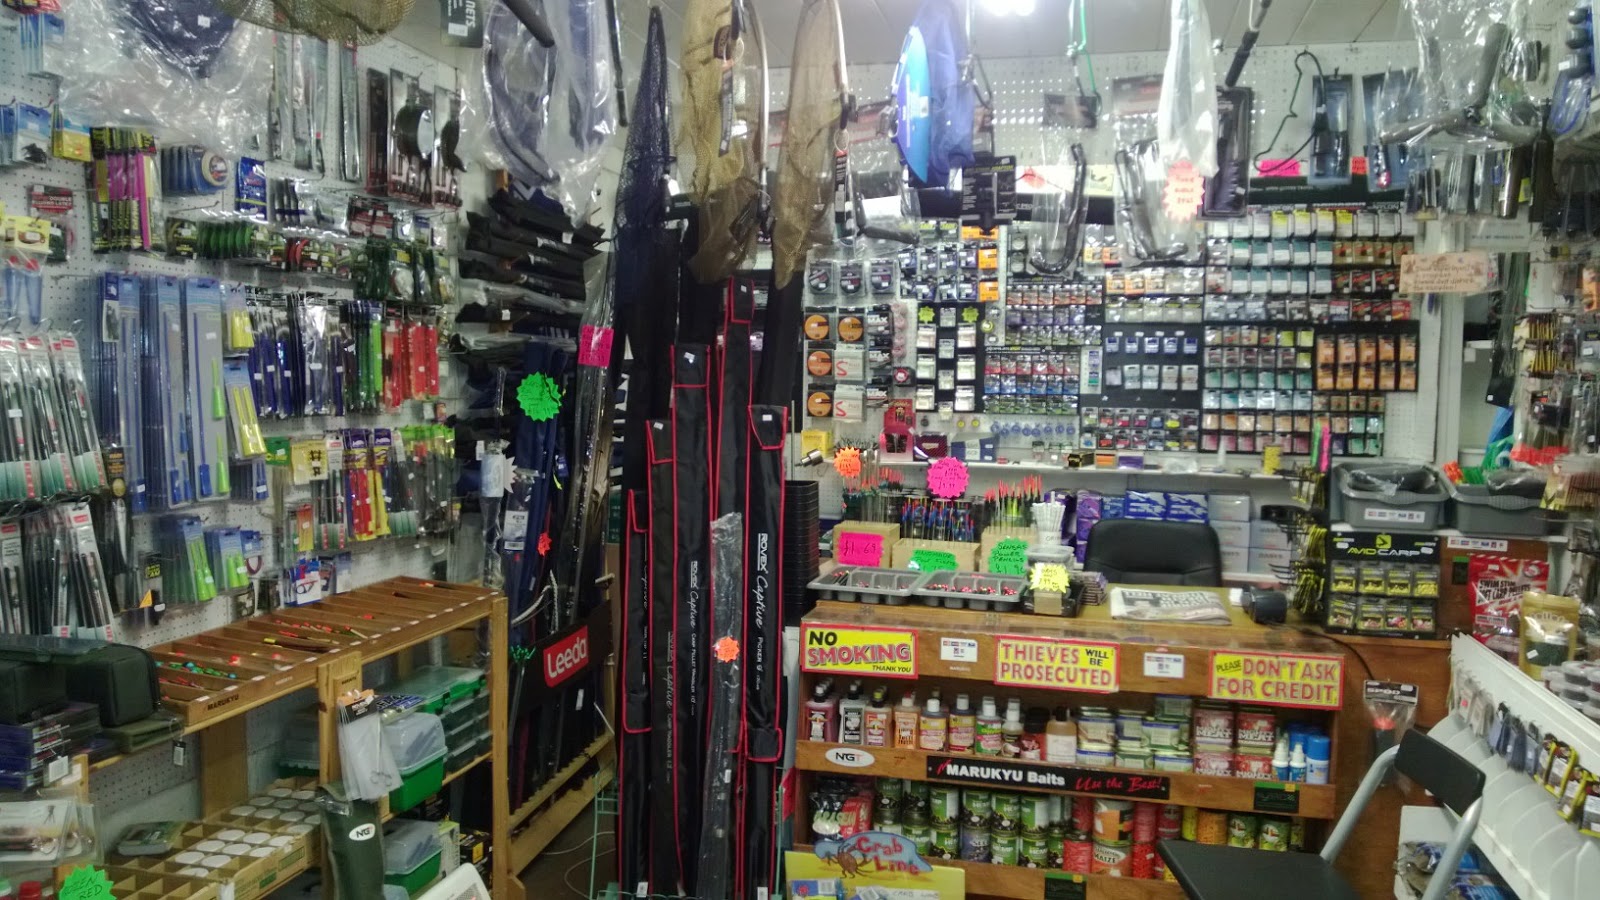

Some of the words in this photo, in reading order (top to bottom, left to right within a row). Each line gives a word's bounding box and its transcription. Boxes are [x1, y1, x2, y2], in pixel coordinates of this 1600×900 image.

[758, 533, 768, 571] ROVEX
[690, 560, 698, 588] ROVEX
[687, 590, 699, 629] Captive
[752, 575, 769, 629] Captive
[808, 631, 838, 646] NO
[547, 636, 587, 678] Leeda
[807, 643, 912, 667] SMOKING
[1001, 643, 1079, 665] THIEVES
[1085, 648, 1109, 659] WILL
[1089, 657, 1103, 667] BE
[1001, 662, 1112, 686] PROSECUTED
[1216, 660, 1242, 673] PLEASE
[1243, 658, 1297, 678] DON'T
[1301, 662, 1336, 681] ASK
[1217, 677, 1255, 697] FOR
[1261, 681, 1334, 702] CREDIT
[836, 752, 863, 762] NGT
[946, 763, 1023, 782] MARUKYU
[1027, 771, 1066, 786] Baits
[1075, 777, 1101, 791] Use
[1106, 777, 1123, 789] the
[1128, 777, 1162, 792] Best!
[856, 835, 903, 856] Crab
[872, 855, 920, 877] Line
